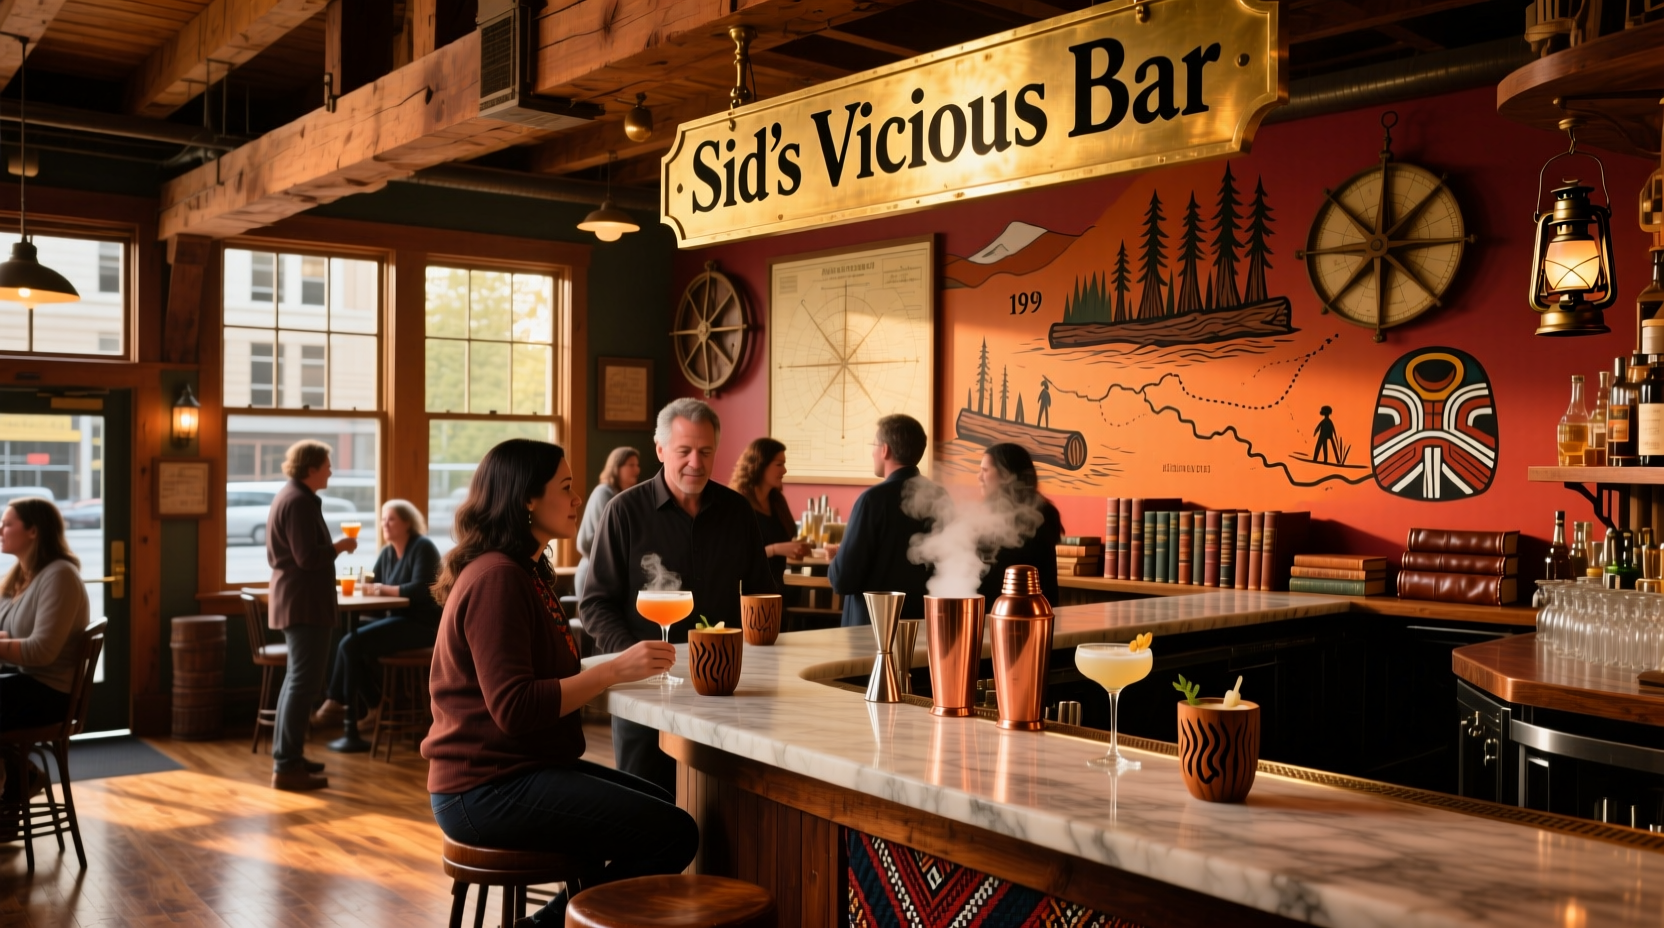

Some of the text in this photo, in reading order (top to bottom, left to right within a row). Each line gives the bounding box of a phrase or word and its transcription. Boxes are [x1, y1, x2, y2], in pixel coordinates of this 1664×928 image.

[692, 37, 1223, 214] Sid's Vicious Bar
[1009, 291, 1042, 315] 199
